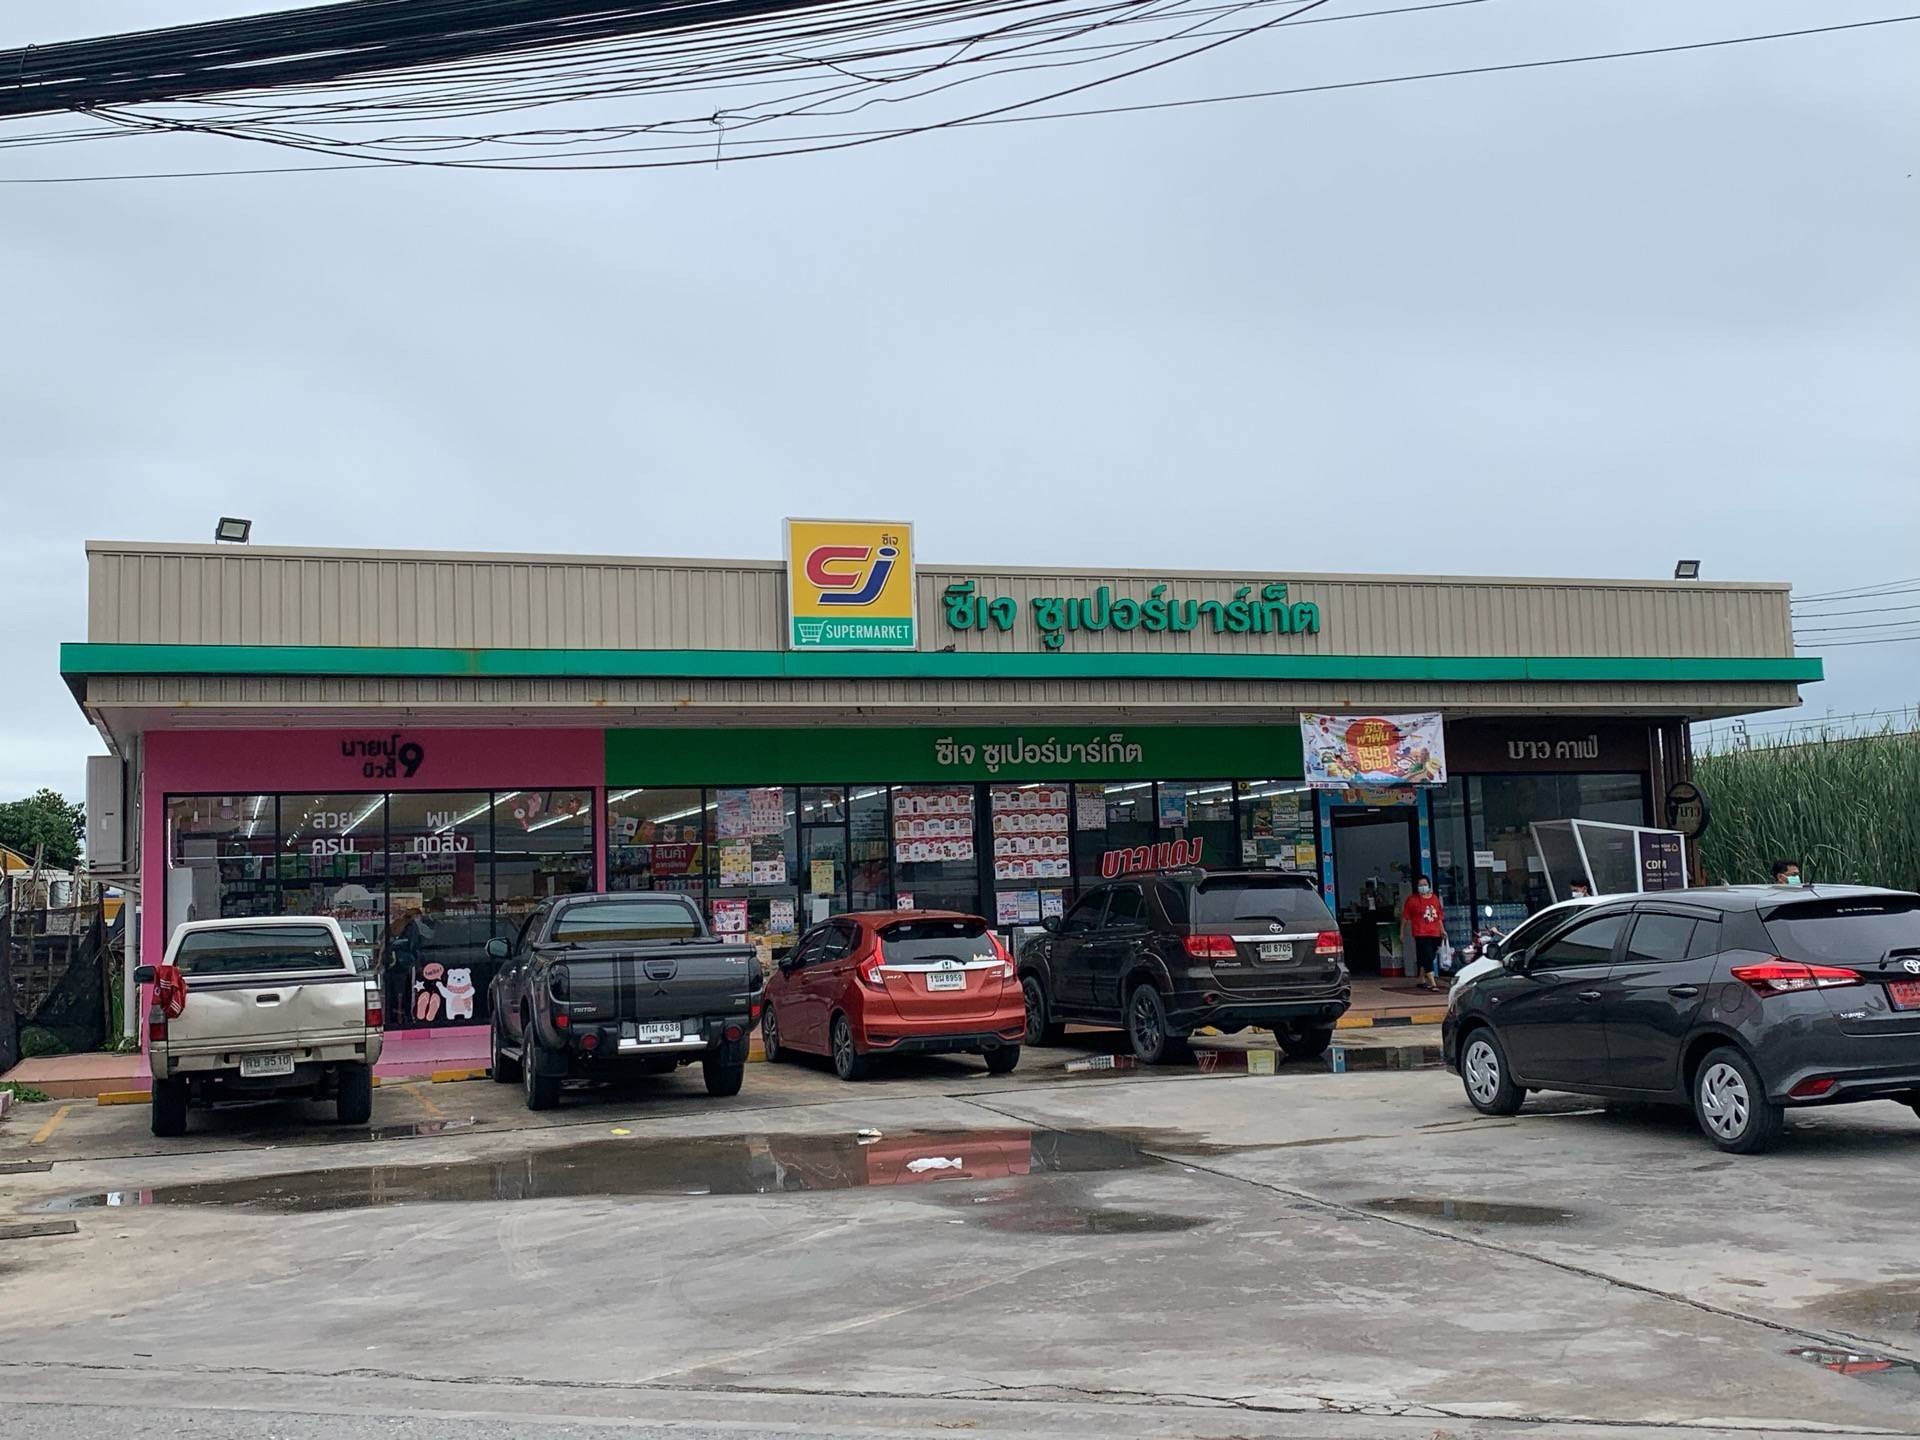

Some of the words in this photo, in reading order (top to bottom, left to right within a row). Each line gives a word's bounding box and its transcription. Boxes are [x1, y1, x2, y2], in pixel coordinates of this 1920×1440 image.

[881, 533, 899, 546] ซีเจ
[942, 580, 1018, 631] ซีเจ
[1032, 583, 1321, 649] ซูเปอร์มาร์เก็ต
[826, 624, 910, 639] SUPERMARKET
[935, 736, 976, 765] ซีเจ
[982, 733, 1143, 773] ซูเปอร์มาร์เก็ต
[1507, 740, 1551, 759] บาว
[312, 811, 353, 829] สวย
[312, 837, 355, 855] ครบ
[413, 828, 469, 859] ทุกสิ่ง
[1646, 860, 1667, 870] CDM
[659, 1023, 680, 1033] 4938
